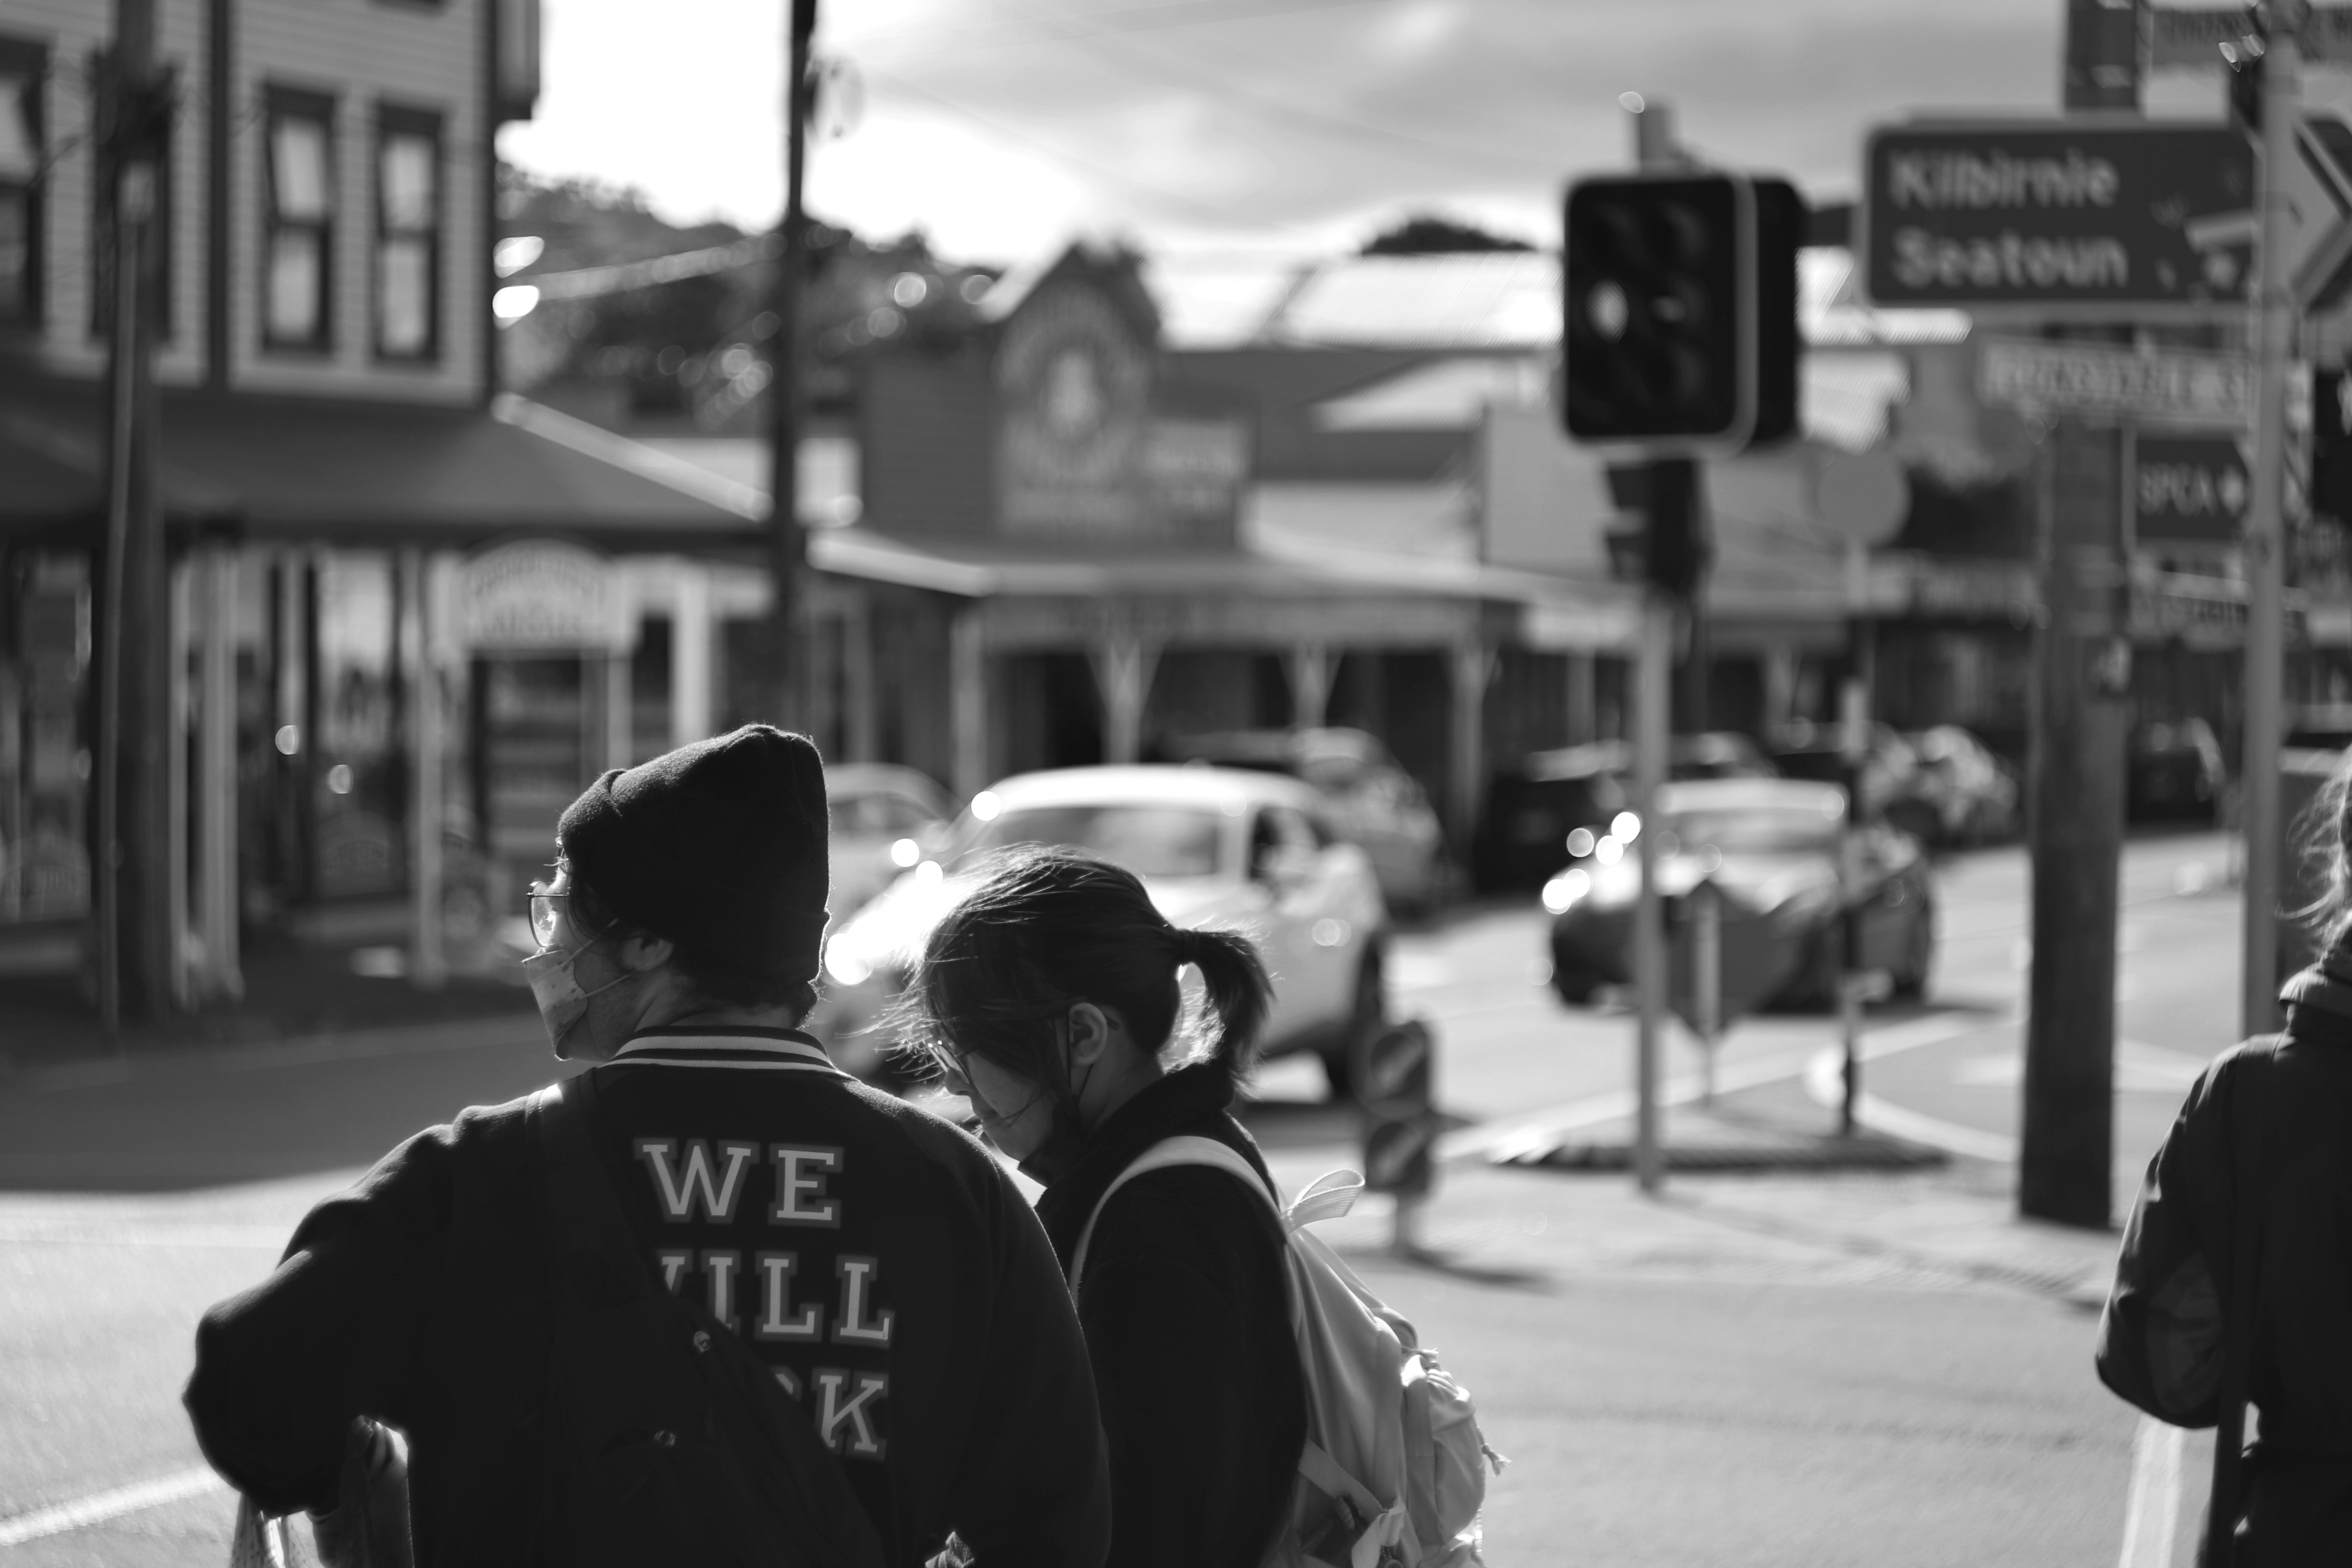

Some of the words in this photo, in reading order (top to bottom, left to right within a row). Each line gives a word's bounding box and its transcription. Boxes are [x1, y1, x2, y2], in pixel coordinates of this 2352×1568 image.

[1890, 148, 2120, 209] Kilbirnie
[1894, 226, 2129, 287] Seatoun
[2137, 462, 2217, 517] SPCA
[633, 1138, 844, 1228] WE
